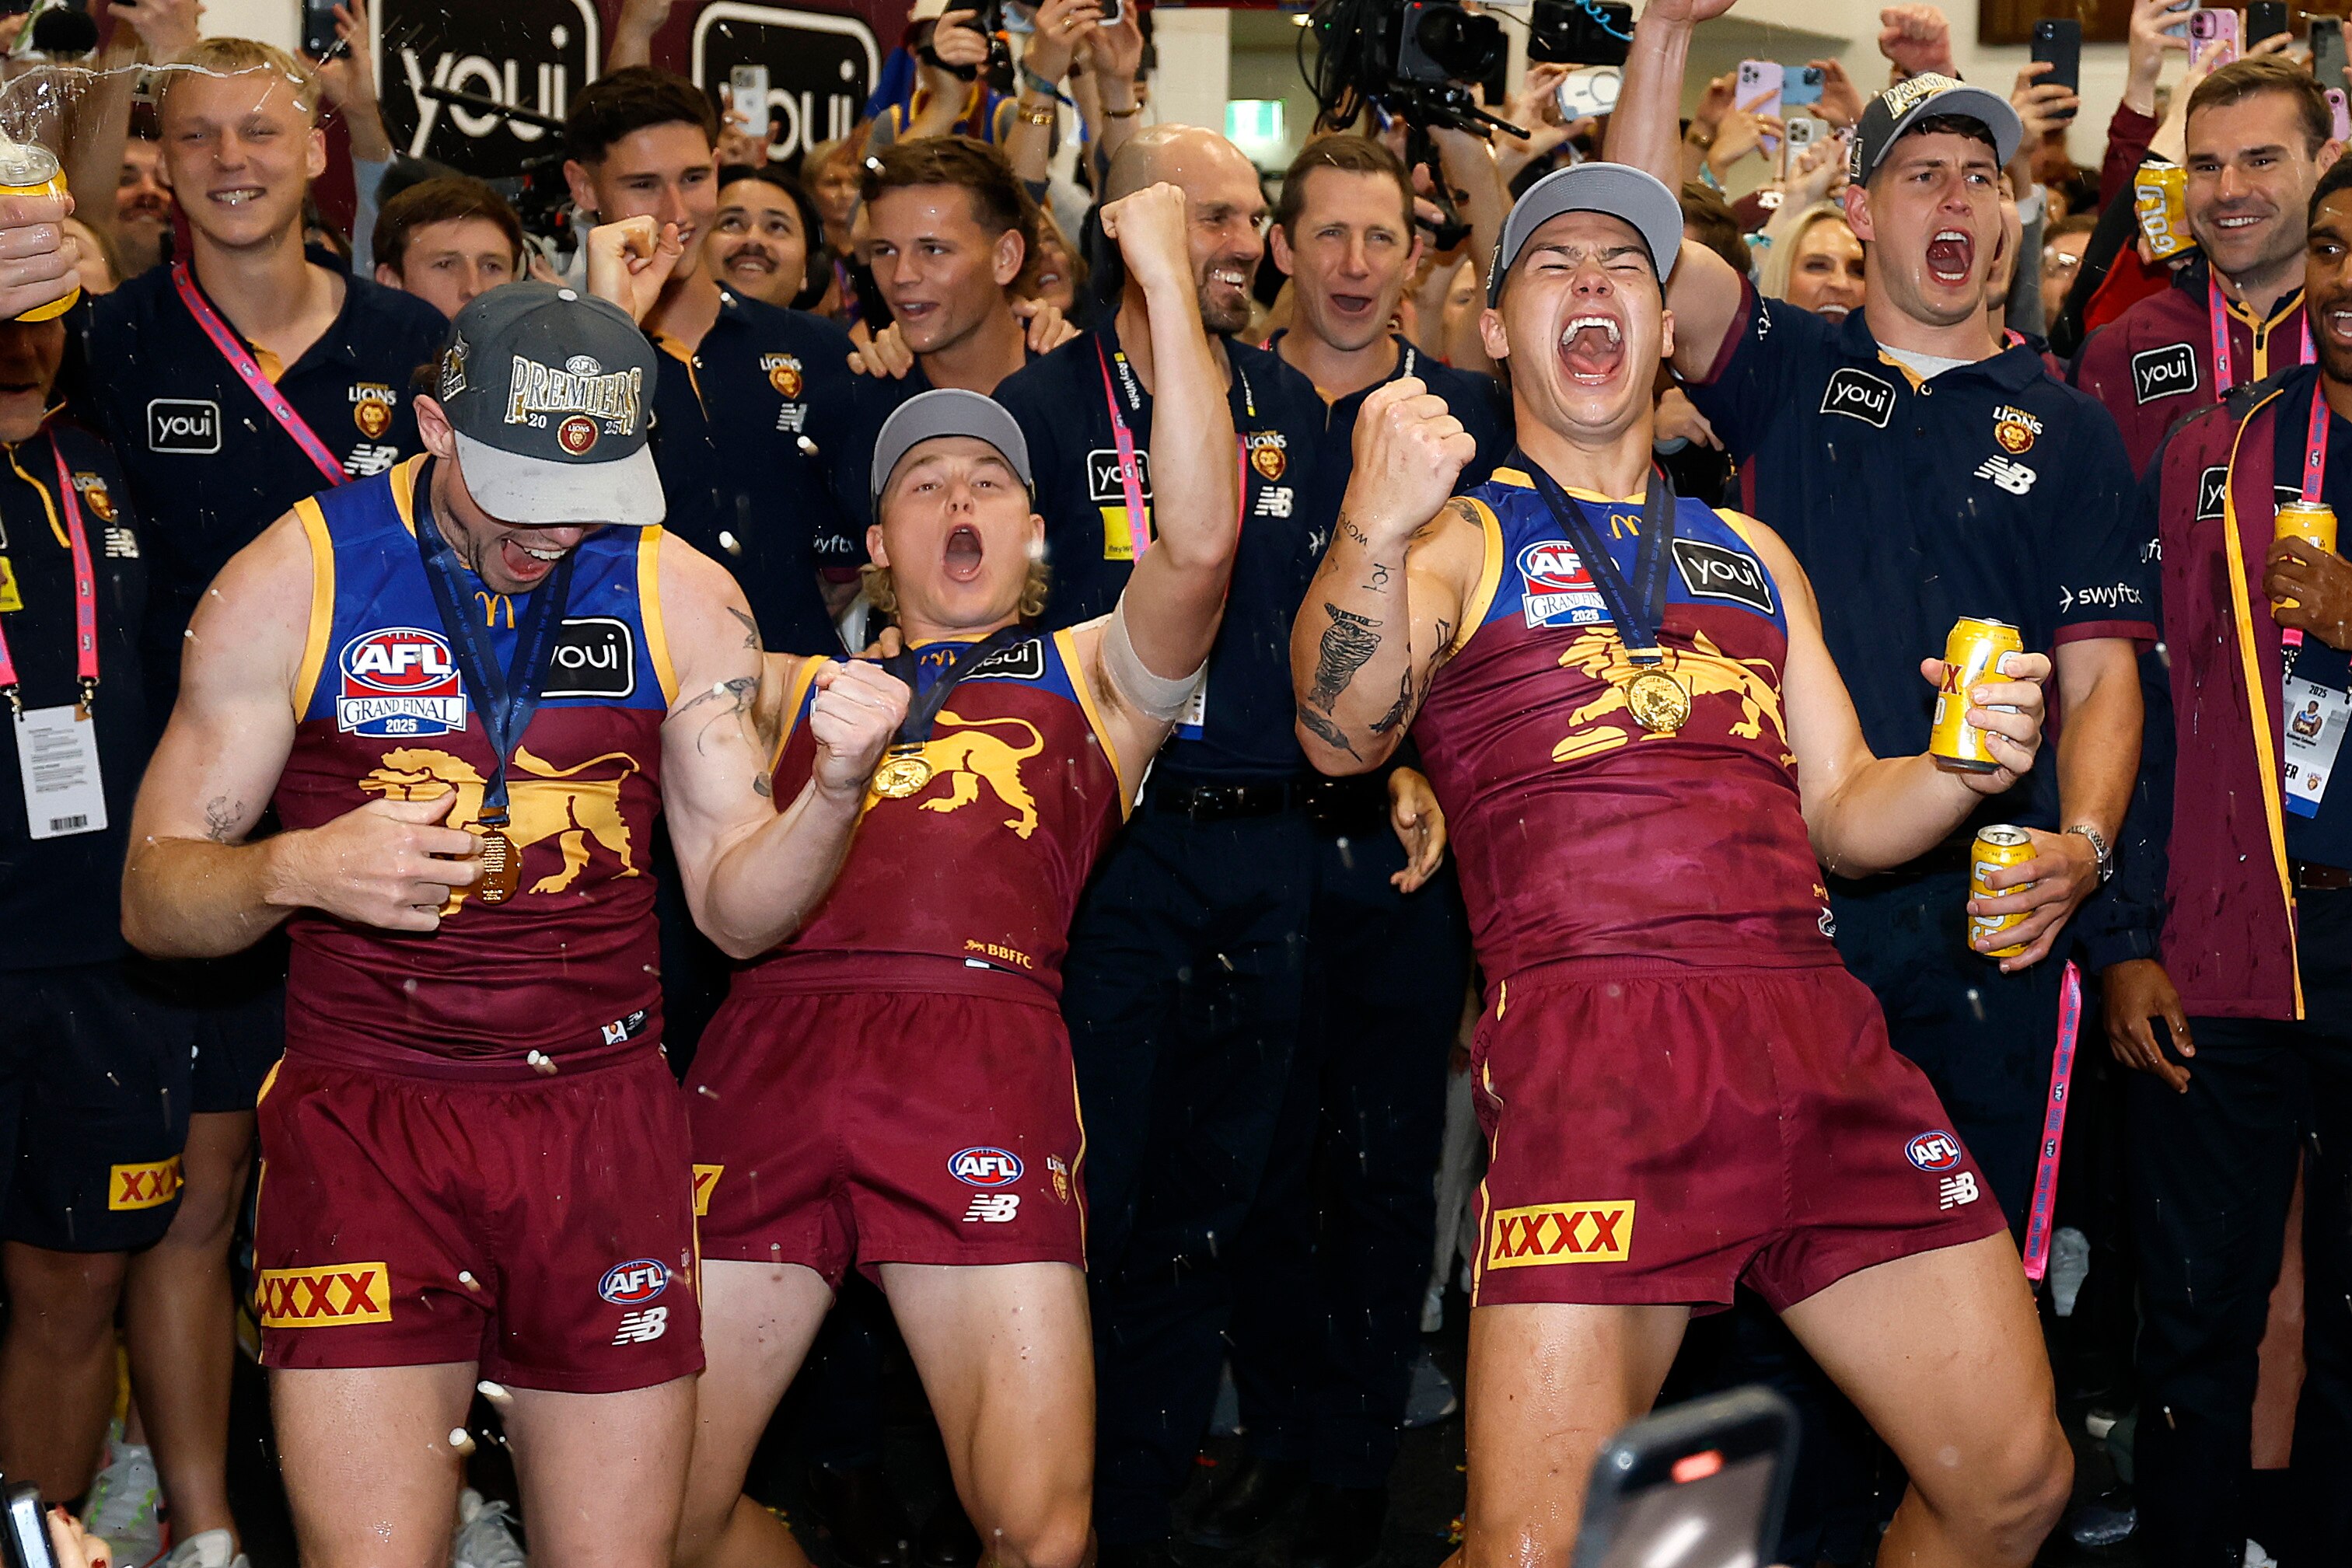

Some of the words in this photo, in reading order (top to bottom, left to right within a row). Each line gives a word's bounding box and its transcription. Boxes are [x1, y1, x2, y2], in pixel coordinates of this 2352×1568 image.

[401, 24, 569, 159] youi
[718, 59, 854, 162] oui
[2137, 185, 2176, 254] GOLD
[571, 361, 599, 373] AFL
[2141, 352, 2186, 393] youi
[349, 386, 397, 406] LIONS
[505, 354, 642, 435] PREMIERS
[1833, 382, 1887, 412] youi
[157, 410, 211, 442] youi
[528, 413, 547, 428] 20
[1993, 406, 2043, 435] LIONS
[1245, 433, 1288, 449] LIONS
[1097, 459, 1145, 491] yoi
[1531, 553, 1581, 576] AF
[1688, 557, 1759, 590] youi
[1531, 593, 1580, 618] GRAND
[1582, 593, 1606, 608] FIN
[2079, 582, 2144, 609] swyftx
[1571, 609, 1600, 622] 2025
[351, 644, 453, 675] AFL
[550, 633, 617, 670] oui
[2308, 685, 2328, 698] 2025
[344, 699, 400, 724] GRAND
[404, 699, 460, 724] FINAL
[386, 719, 418, 733] 2025
[987, 943, 1033, 969] BBFFC
[1914, 1138, 1959, 1165] AFL
[957, 1157, 1017, 1176] AFL
[1493, 1210, 1625, 1260] XXXX
[257, 1271, 380, 1318] XXXX
[603, 1267, 664, 1298] AFL
